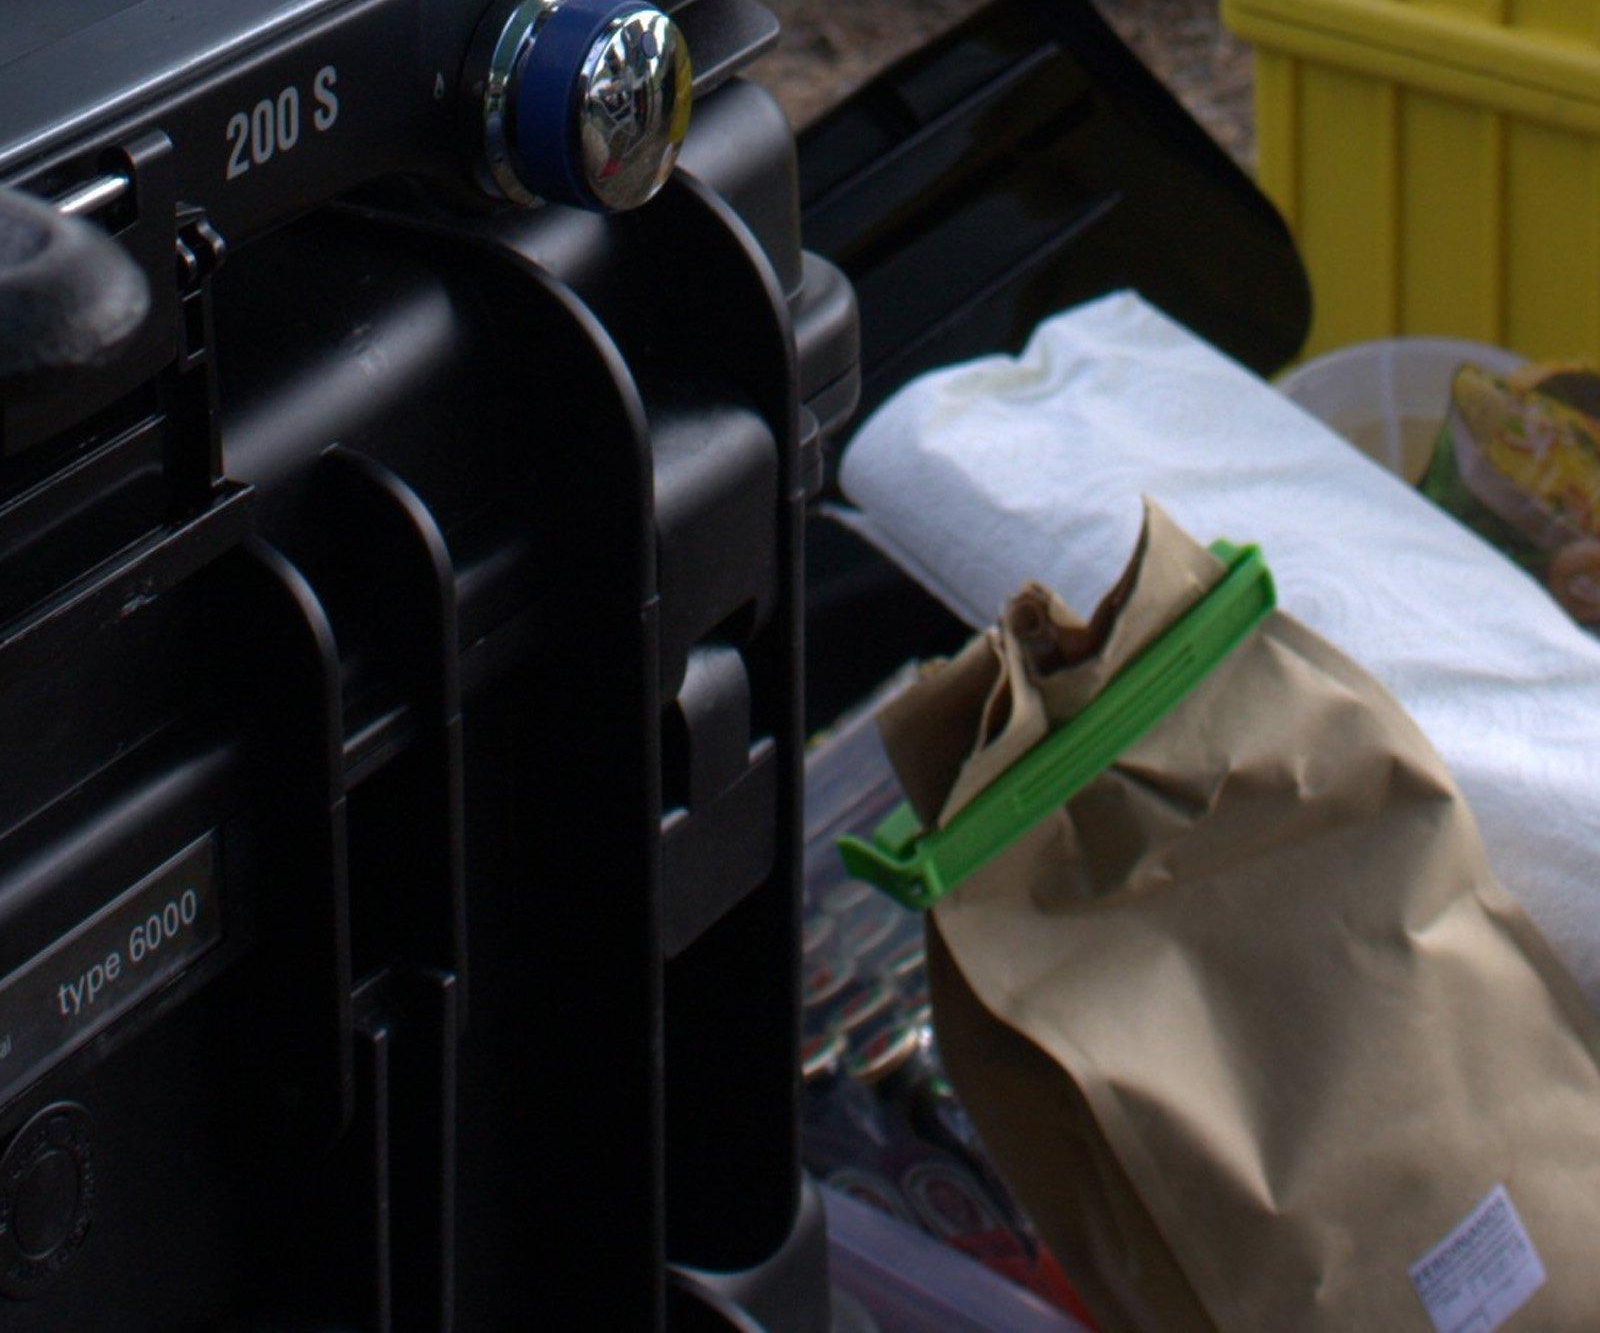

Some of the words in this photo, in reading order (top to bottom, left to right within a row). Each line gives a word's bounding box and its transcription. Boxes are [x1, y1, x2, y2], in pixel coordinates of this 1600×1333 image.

[226, 86, 300, 181] 200
[313, 64, 339, 131] S
[58, 952, 121, 1015] type
[129, 889, 197, 963] 6000
